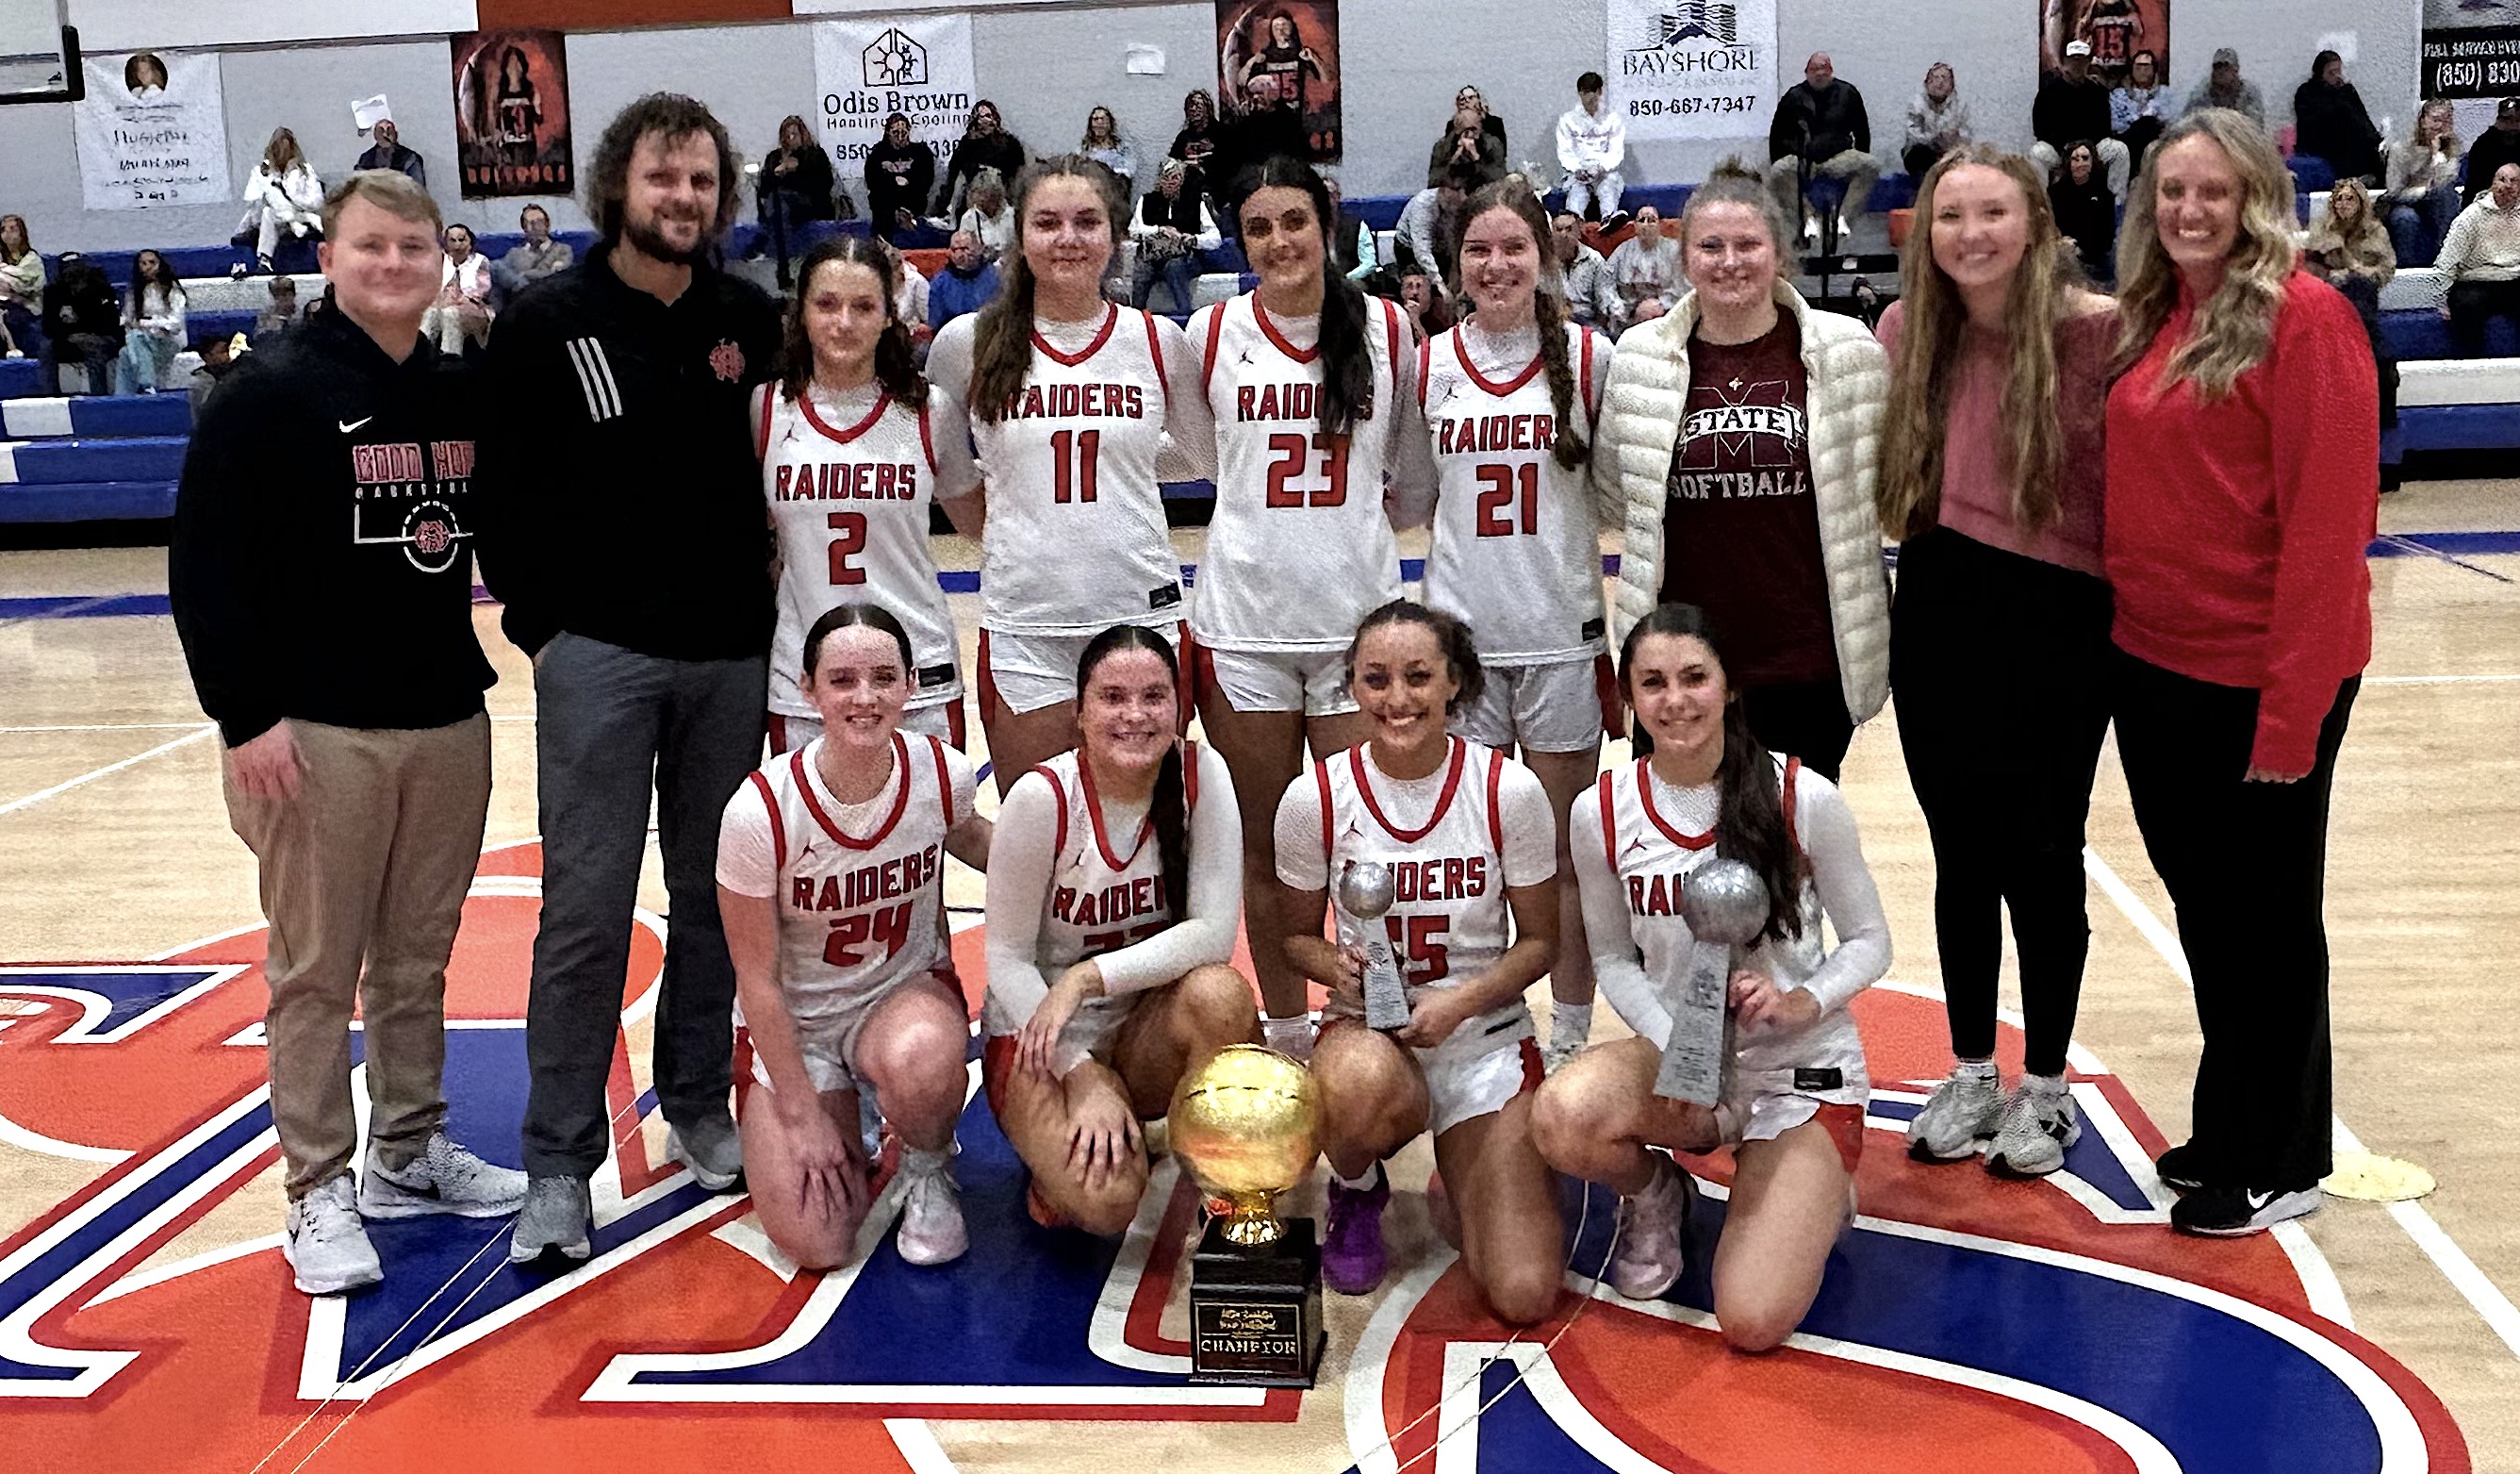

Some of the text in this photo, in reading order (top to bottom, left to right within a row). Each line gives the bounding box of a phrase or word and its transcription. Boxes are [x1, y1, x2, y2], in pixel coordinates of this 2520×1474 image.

[2436, 60, 2482, 91] (850)
[824, 91, 968, 114] Odis Brown
[1630, 95, 1756, 116] 850-667-7347
[1439, 414, 1556, 455] RAIDER
[1685, 407, 1787, 434] STATE
[776, 463, 916, 502] RAIDERS
[1050, 429, 1100, 505] 11
[1266, 433, 1350, 508] 23
[1668, 471, 1807, 500] SOFTBALL
[1475, 462, 1539, 537] 21
[828, 512, 867, 586] 2
[793, 842, 938, 912] RAIDERS
[1053, 874, 1166, 926] RAIDE
[822, 899, 914, 968] 24
